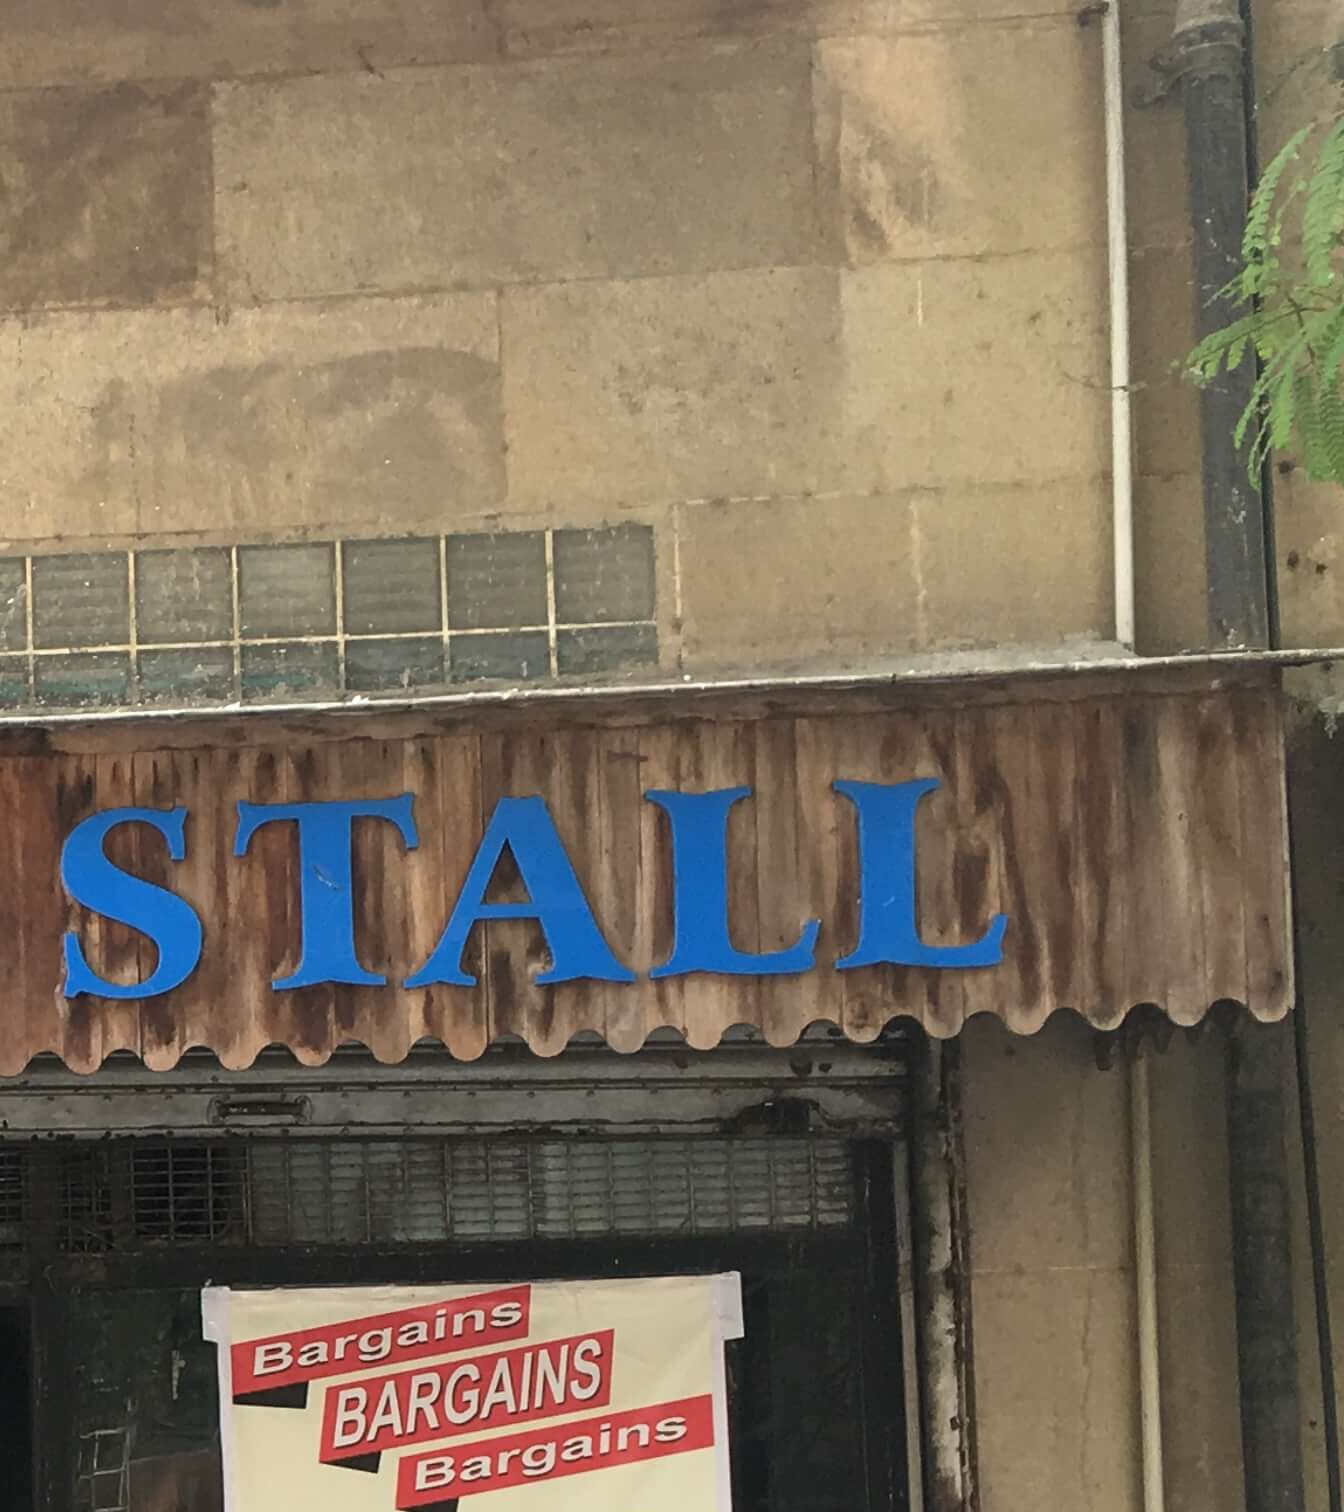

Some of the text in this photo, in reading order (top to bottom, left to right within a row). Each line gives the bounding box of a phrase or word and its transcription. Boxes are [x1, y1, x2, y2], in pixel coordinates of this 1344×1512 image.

[60, 777, 1007, 998] STALL
[252, 1299, 523, 1377] Bargains
[333, 1339, 603, 1448] BARGAINS
[415, 1414, 687, 1491] Bargains
